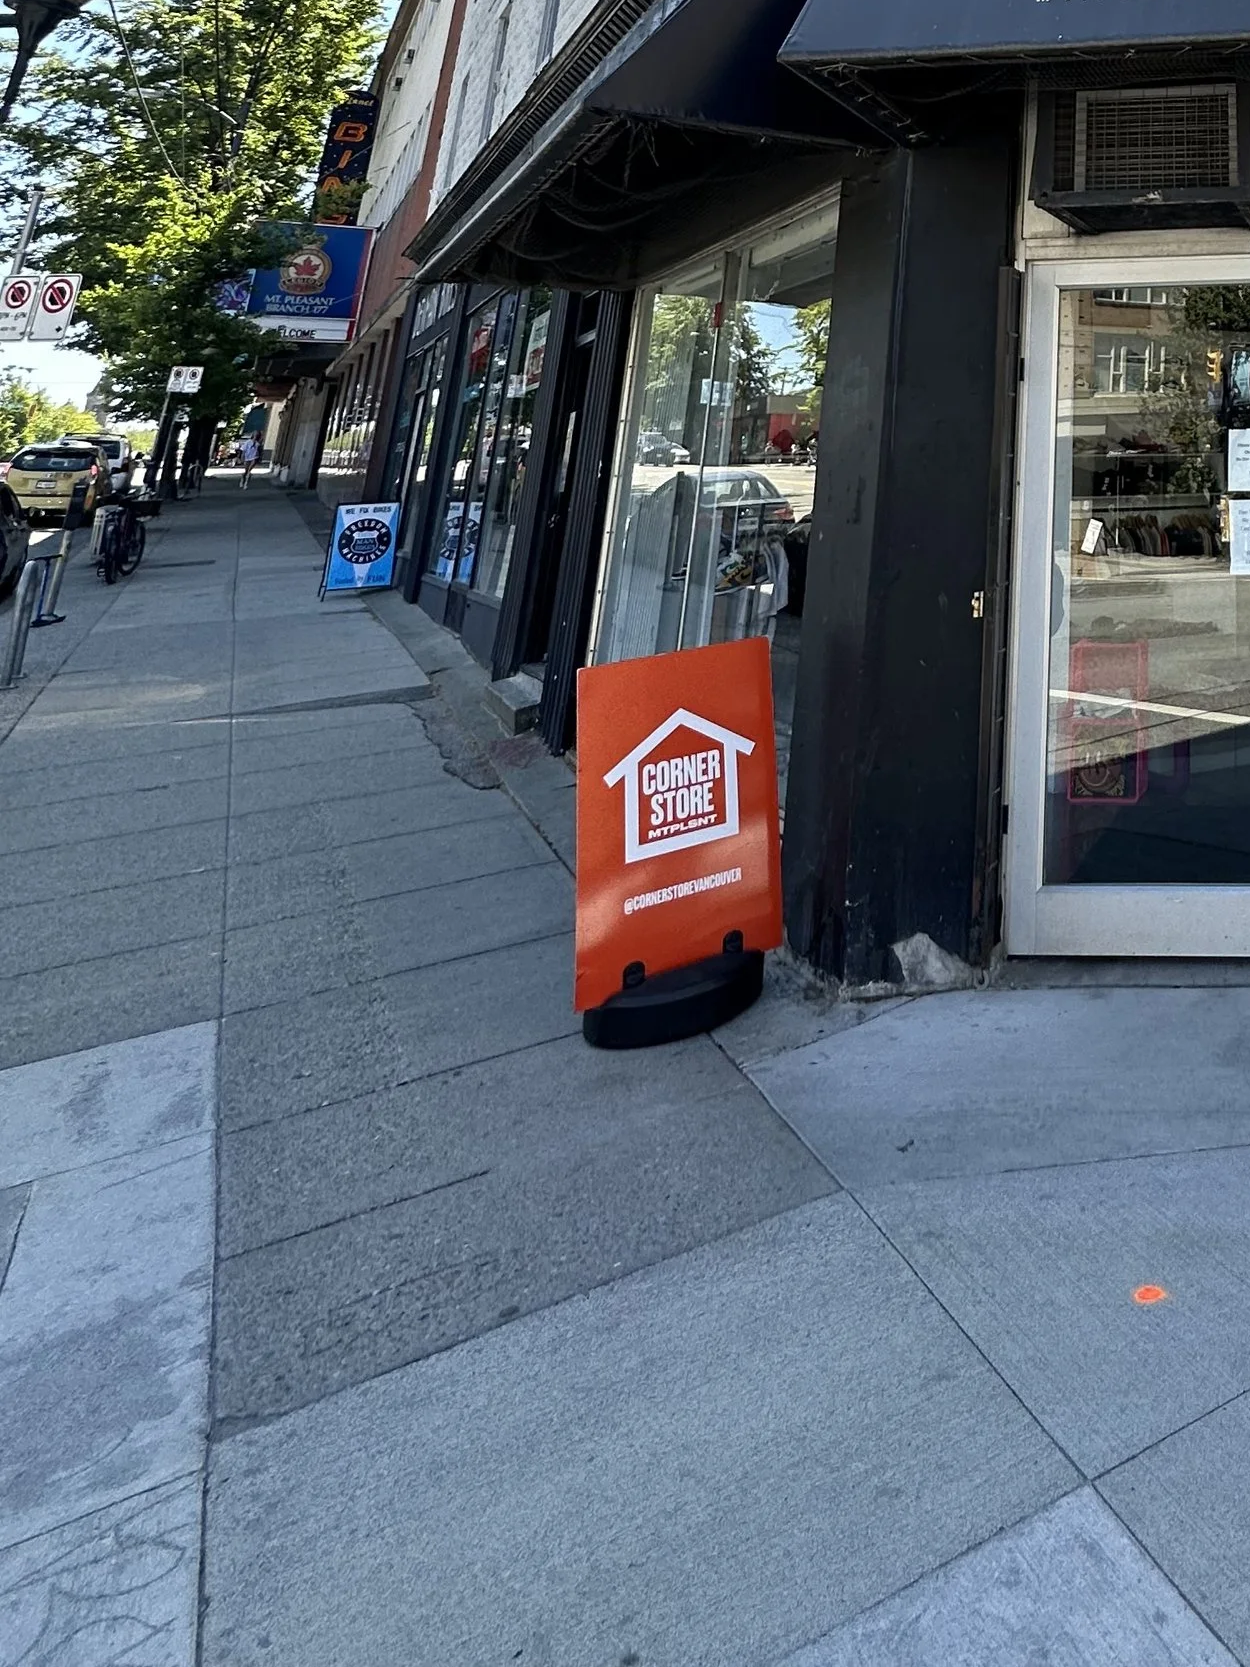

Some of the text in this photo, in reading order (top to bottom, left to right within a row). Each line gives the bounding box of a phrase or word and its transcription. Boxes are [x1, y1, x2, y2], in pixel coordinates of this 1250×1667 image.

[265, 304, 310, 314] BRANCH
[284, 295, 335, 306] PLEASANT
[277, 325, 316, 339] ELCOME
[642, 749, 721, 795] CORNER
[650, 781, 715, 826] STORE
[648, 814, 717, 839] MTPLSNT
[624, 867, 742, 915] @CORNERSTOREVANCOUVER
